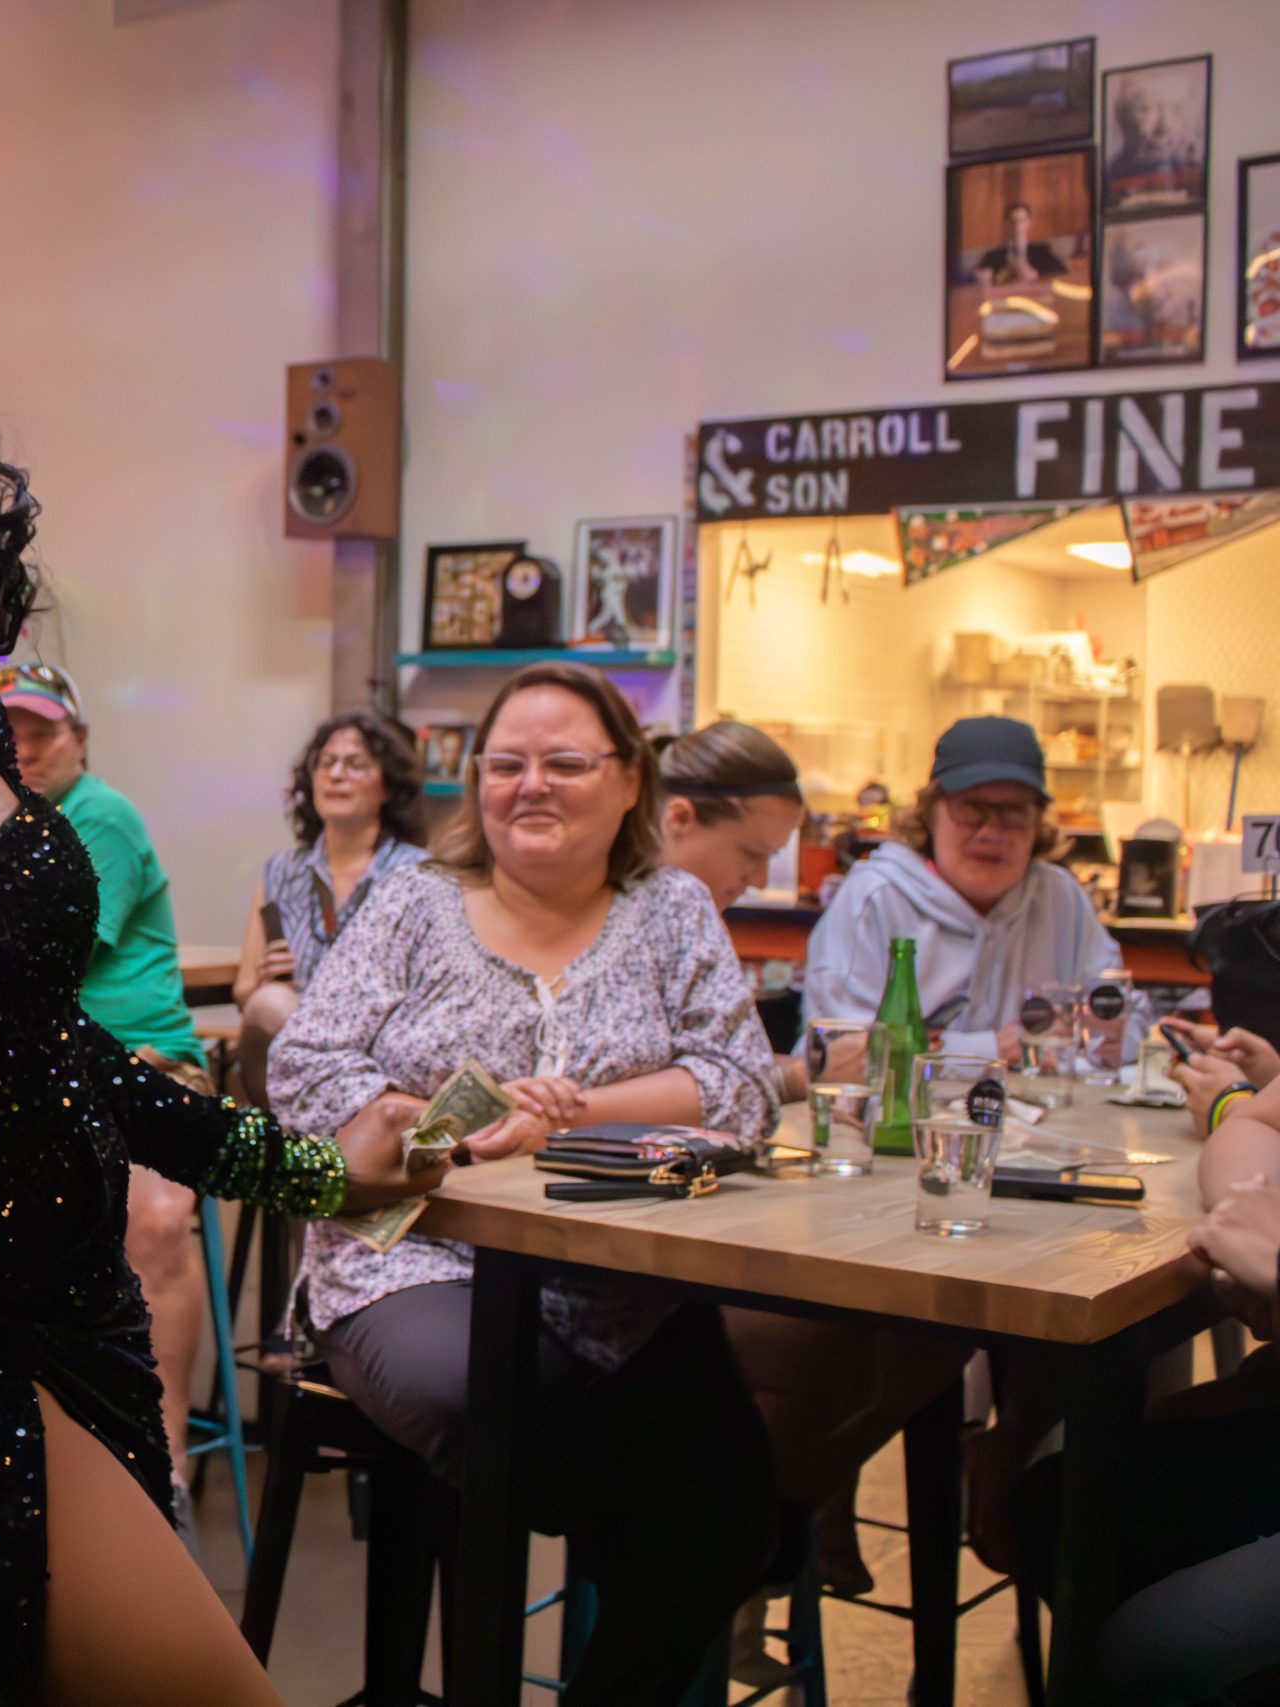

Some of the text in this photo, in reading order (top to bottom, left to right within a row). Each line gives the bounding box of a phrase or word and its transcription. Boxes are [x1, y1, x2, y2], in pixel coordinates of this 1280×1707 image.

[765, 411, 962, 462] CARROLL
[1016, 388, 1259, 498] FINE
[699, 428, 756, 514] &
[765, 470, 849, 513] SON
[1251, 821, 1280, 858] 7
